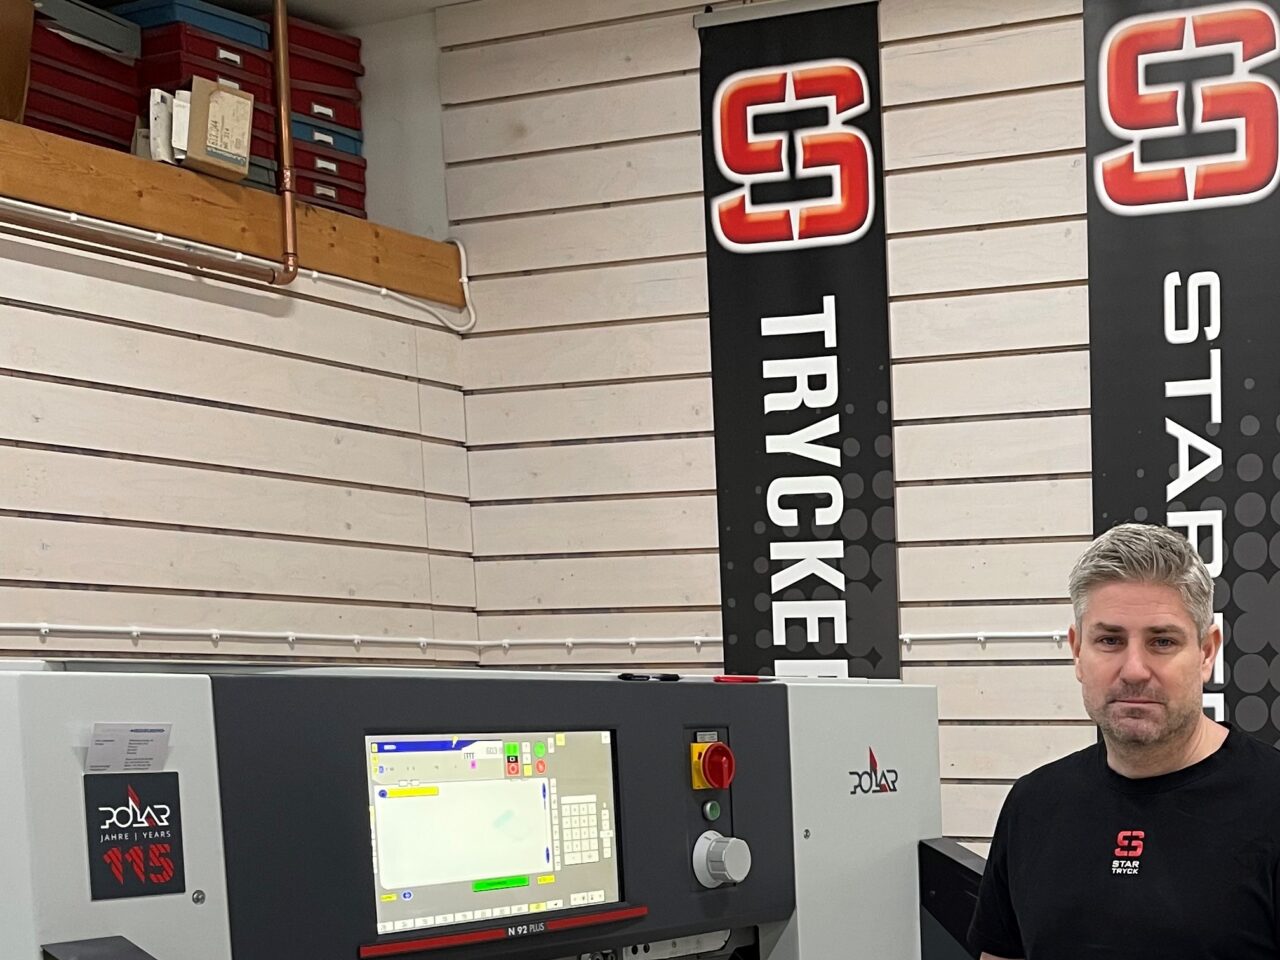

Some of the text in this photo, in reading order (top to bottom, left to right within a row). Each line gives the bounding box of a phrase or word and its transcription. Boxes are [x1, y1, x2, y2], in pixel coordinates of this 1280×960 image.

[849, 766, 899, 795] POLAR
[98, 796, 171, 829] POLAR
[100, 832, 129, 843] JAHRE
[142, 830, 171, 840] YEARS
[103, 843, 174, 885] 115
[1111, 867, 1139, 875] TRYCK
[1112, 860, 1140, 868] STAR
[508, 922, 545, 937] N 92 PLUS
